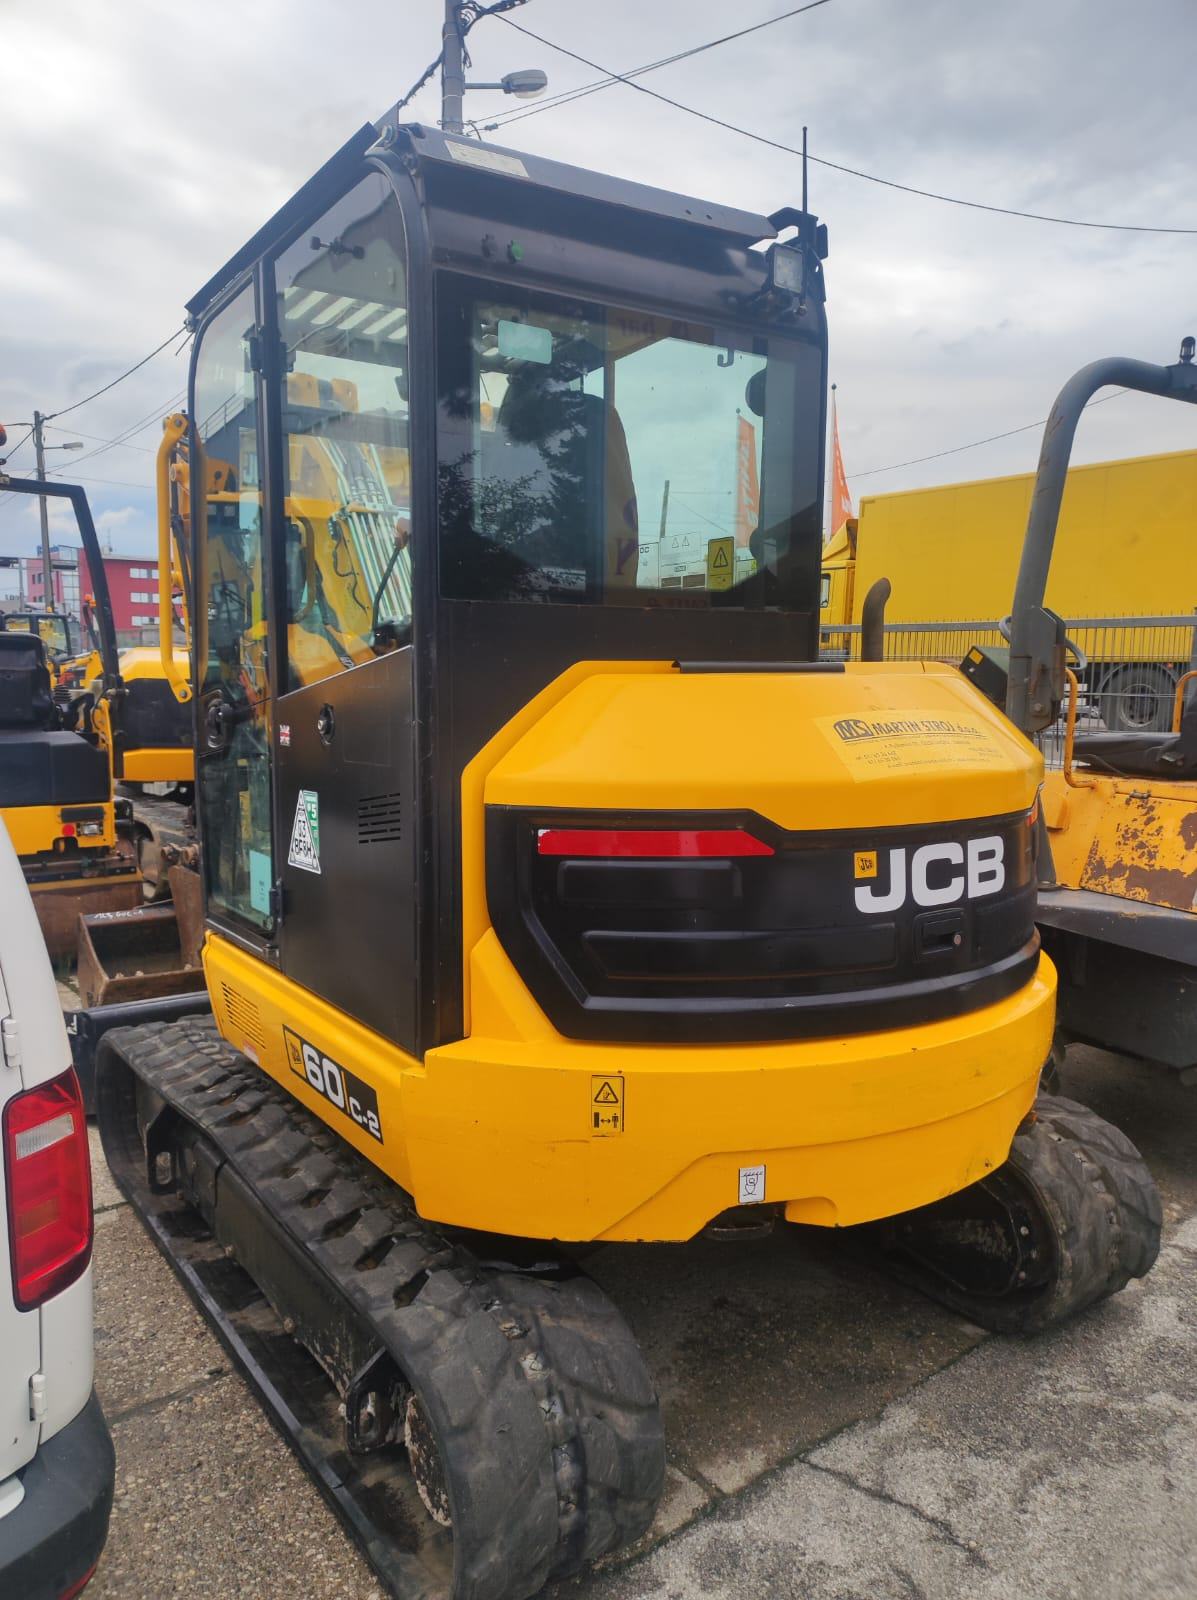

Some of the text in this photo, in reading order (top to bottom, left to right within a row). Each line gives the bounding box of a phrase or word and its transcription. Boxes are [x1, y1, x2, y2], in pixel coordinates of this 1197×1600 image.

[834, 720, 873, 740] MS
[872, 719, 920, 736] MARTIN
[920, 719, 957, 734] STROJ
[854, 835, 1005, 914] JCB
[302, 1043, 381, 1139] 60 C-2
